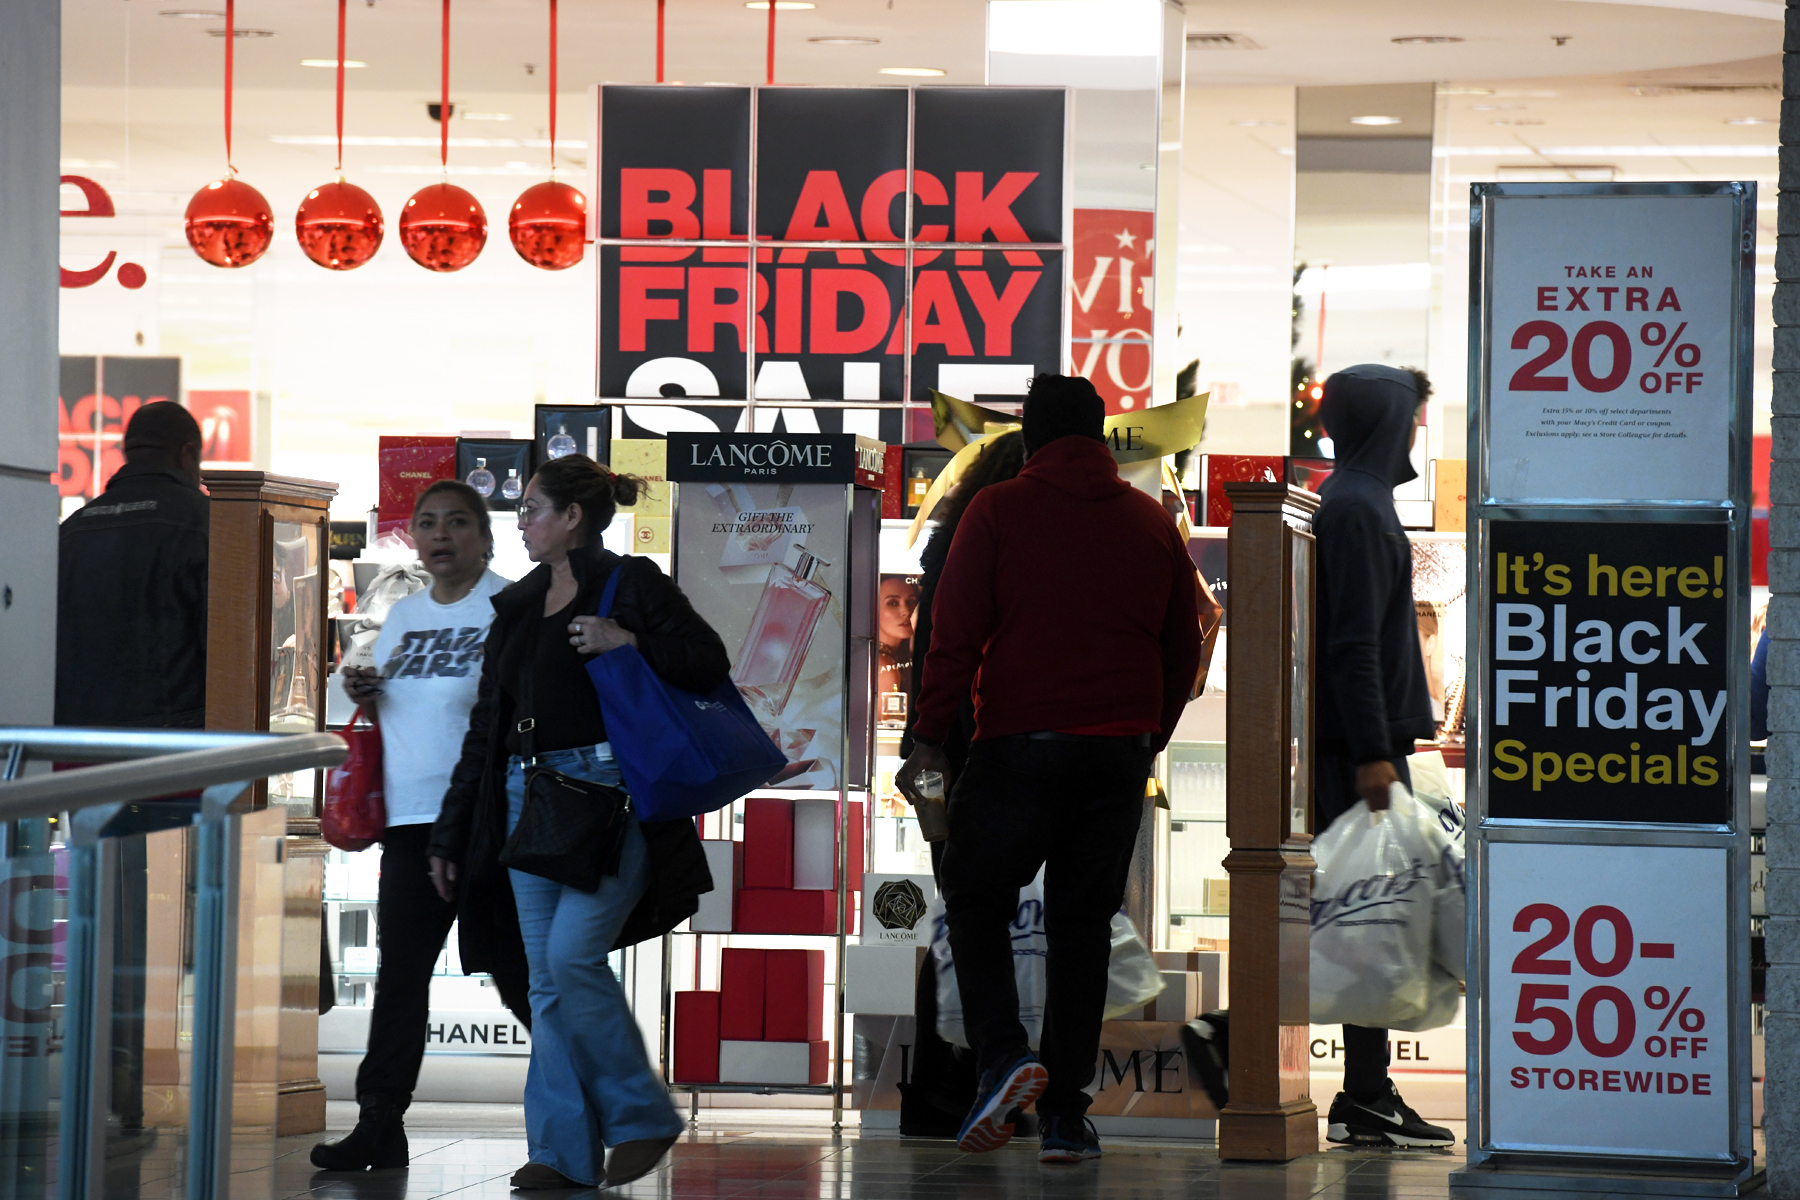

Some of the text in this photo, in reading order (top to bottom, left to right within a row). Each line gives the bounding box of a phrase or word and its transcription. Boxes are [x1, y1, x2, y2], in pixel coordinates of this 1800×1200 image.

[619, 167, 1045, 267] BLACK
[1564, 266, 1653, 278] TAKE AN
[617, 265, 1044, 357] FRIDAY
[1536, 286, 1682, 312] EXTRA
[1639, 372, 1704, 394] OFF
[1599, 407, 1609, 416] off
[1630, 408, 1672, 416] departments
[1525, 430, 1559, 438] Exclusions
[1617, 432, 1651, 440] Colleague
[1652, 432, 1662, 440] for
[690, 439, 832, 467] LANCÔME
[400, 471, 432, 479] CHANEL
[711, 523, 815, 534] EXTRAORDINARY
[738, 512, 794, 522] GIFT THE
[1496, 552, 1724, 599] It's here!
[402, 626, 484, 654] STAR
[1495, 602, 1709, 665] Black
[1495, 669, 1727, 746] Friday
[1491, 739, 1720, 792] Specials
[880, 932, 918, 940] LANCÔME
[1511, 903, 1675, 977] 20-
[426, 1023, 527, 1045] HANEL
[1309, 1038, 1430, 1061] CHEL
[1644, 1036, 1708, 1059] OFF
[1510, 1066, 1712, 1096] STOREWIDE
